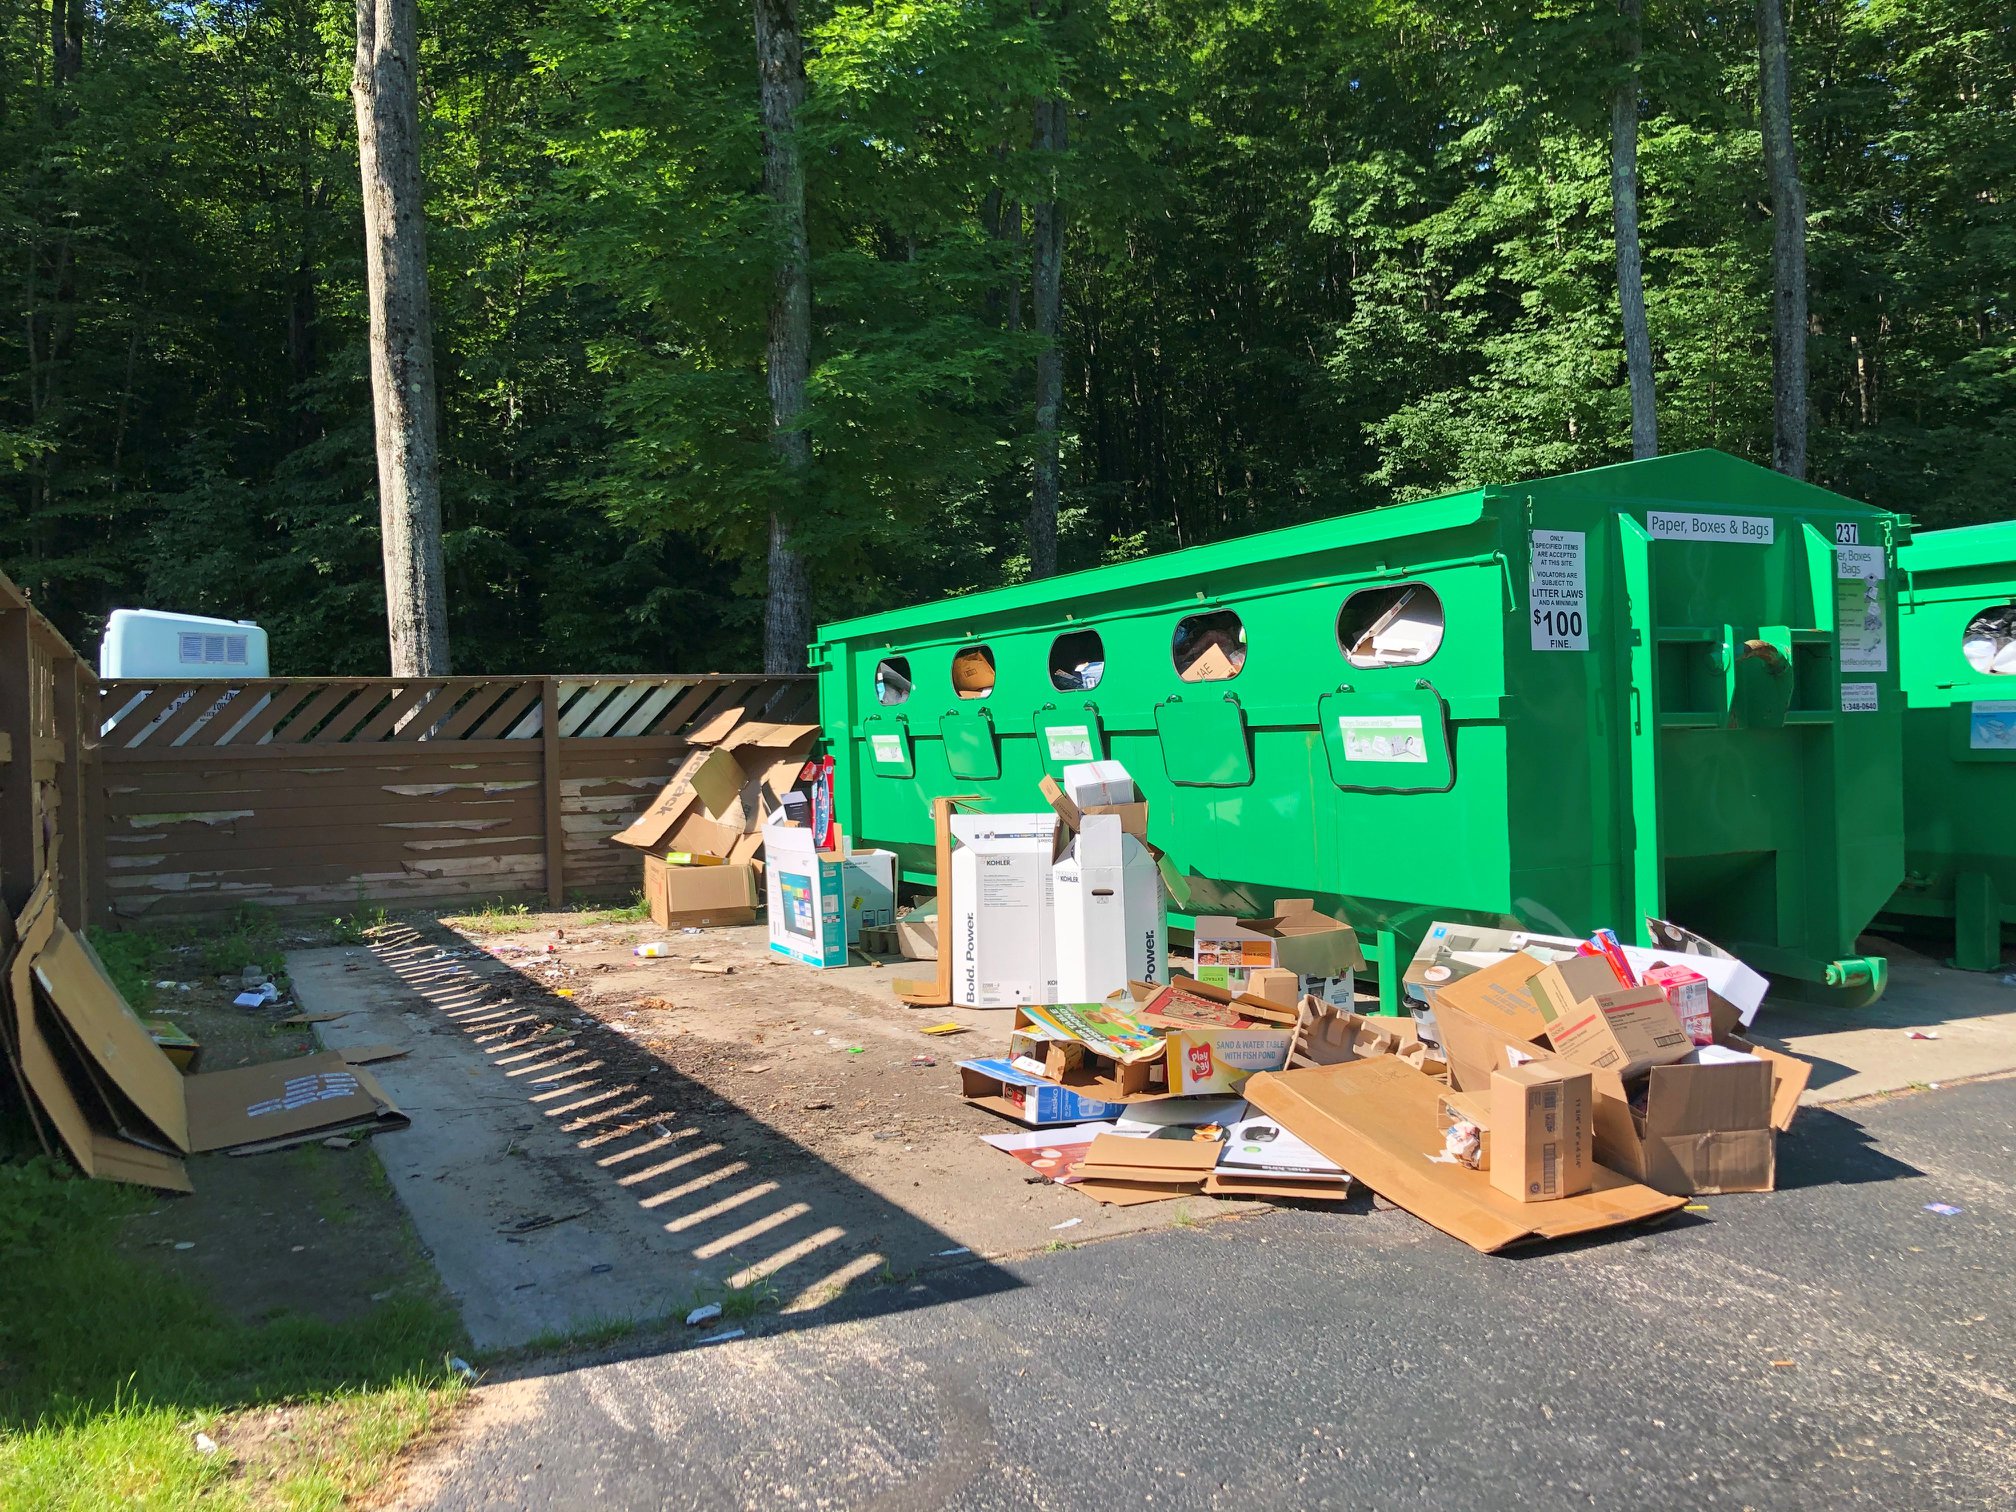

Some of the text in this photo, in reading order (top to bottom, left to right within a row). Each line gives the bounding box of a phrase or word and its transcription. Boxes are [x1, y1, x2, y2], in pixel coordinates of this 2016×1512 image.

[1652, 516, 1769, 539] Paper, Boxes & Bags
[1836, 524, 1857, 543] 237
[1848, 550, 1872, 561] Boxes
[1841, 562, 1861, 577] Bags
[1532, 588, 1584, 599] LITTER LAWS
[1533, 608, 1582, 637] $100
[1550, 639, 1572, 649] FINE.
[965, 912, 976, 1003] Bold. Power.
[1144, 929, 1155, 984] Power.
[1216, 1041, 1284, 1049] SAND & WATER TABLE
[1224, 1051, 1276, 1060] WITH FISH POND
